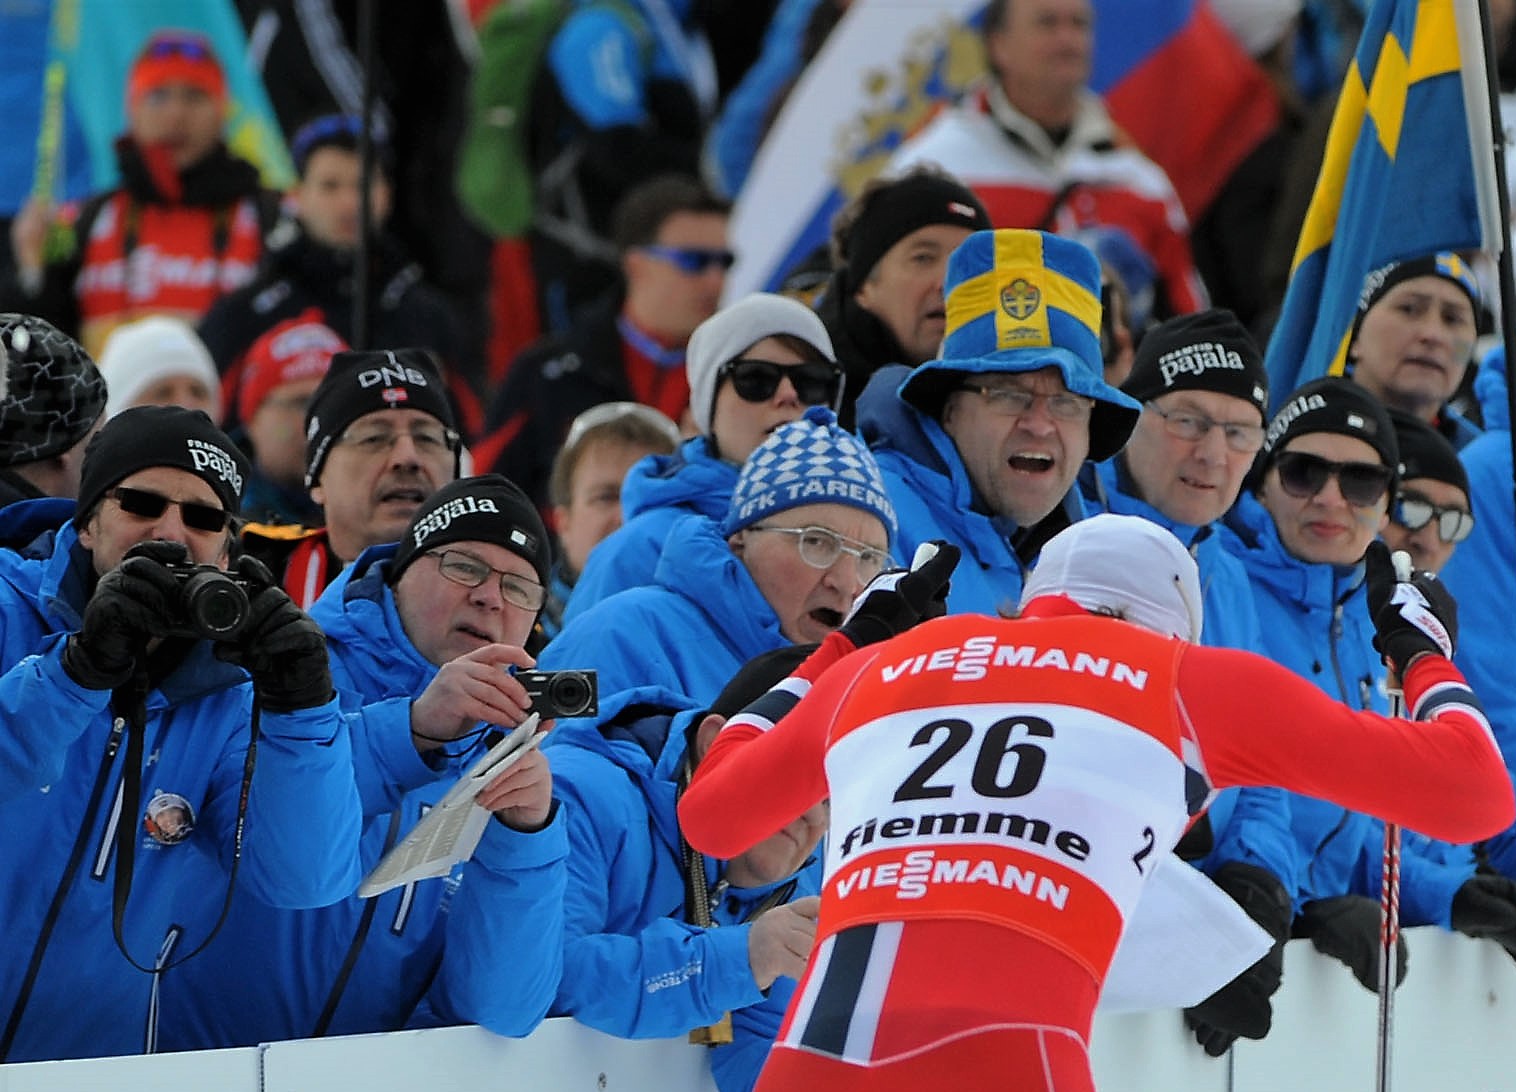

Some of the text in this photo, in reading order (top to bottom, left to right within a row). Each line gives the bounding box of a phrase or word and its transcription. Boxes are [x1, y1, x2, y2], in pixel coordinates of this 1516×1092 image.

[357, 367, 428, 389] DNB
[1160, 343, 1246, 387] pajala
[188, 448, 244, 497] pajala
[413, 495, 501, 550] pajala
[739, 490, 777, 519] IFK
[881, 635, 1149, 691] VIESSMANN
[893, 715, 1054, 803] 26
[841, 811, 1091, 861] fiemme
[836, 850, 1070, 911] VIESSMANN
